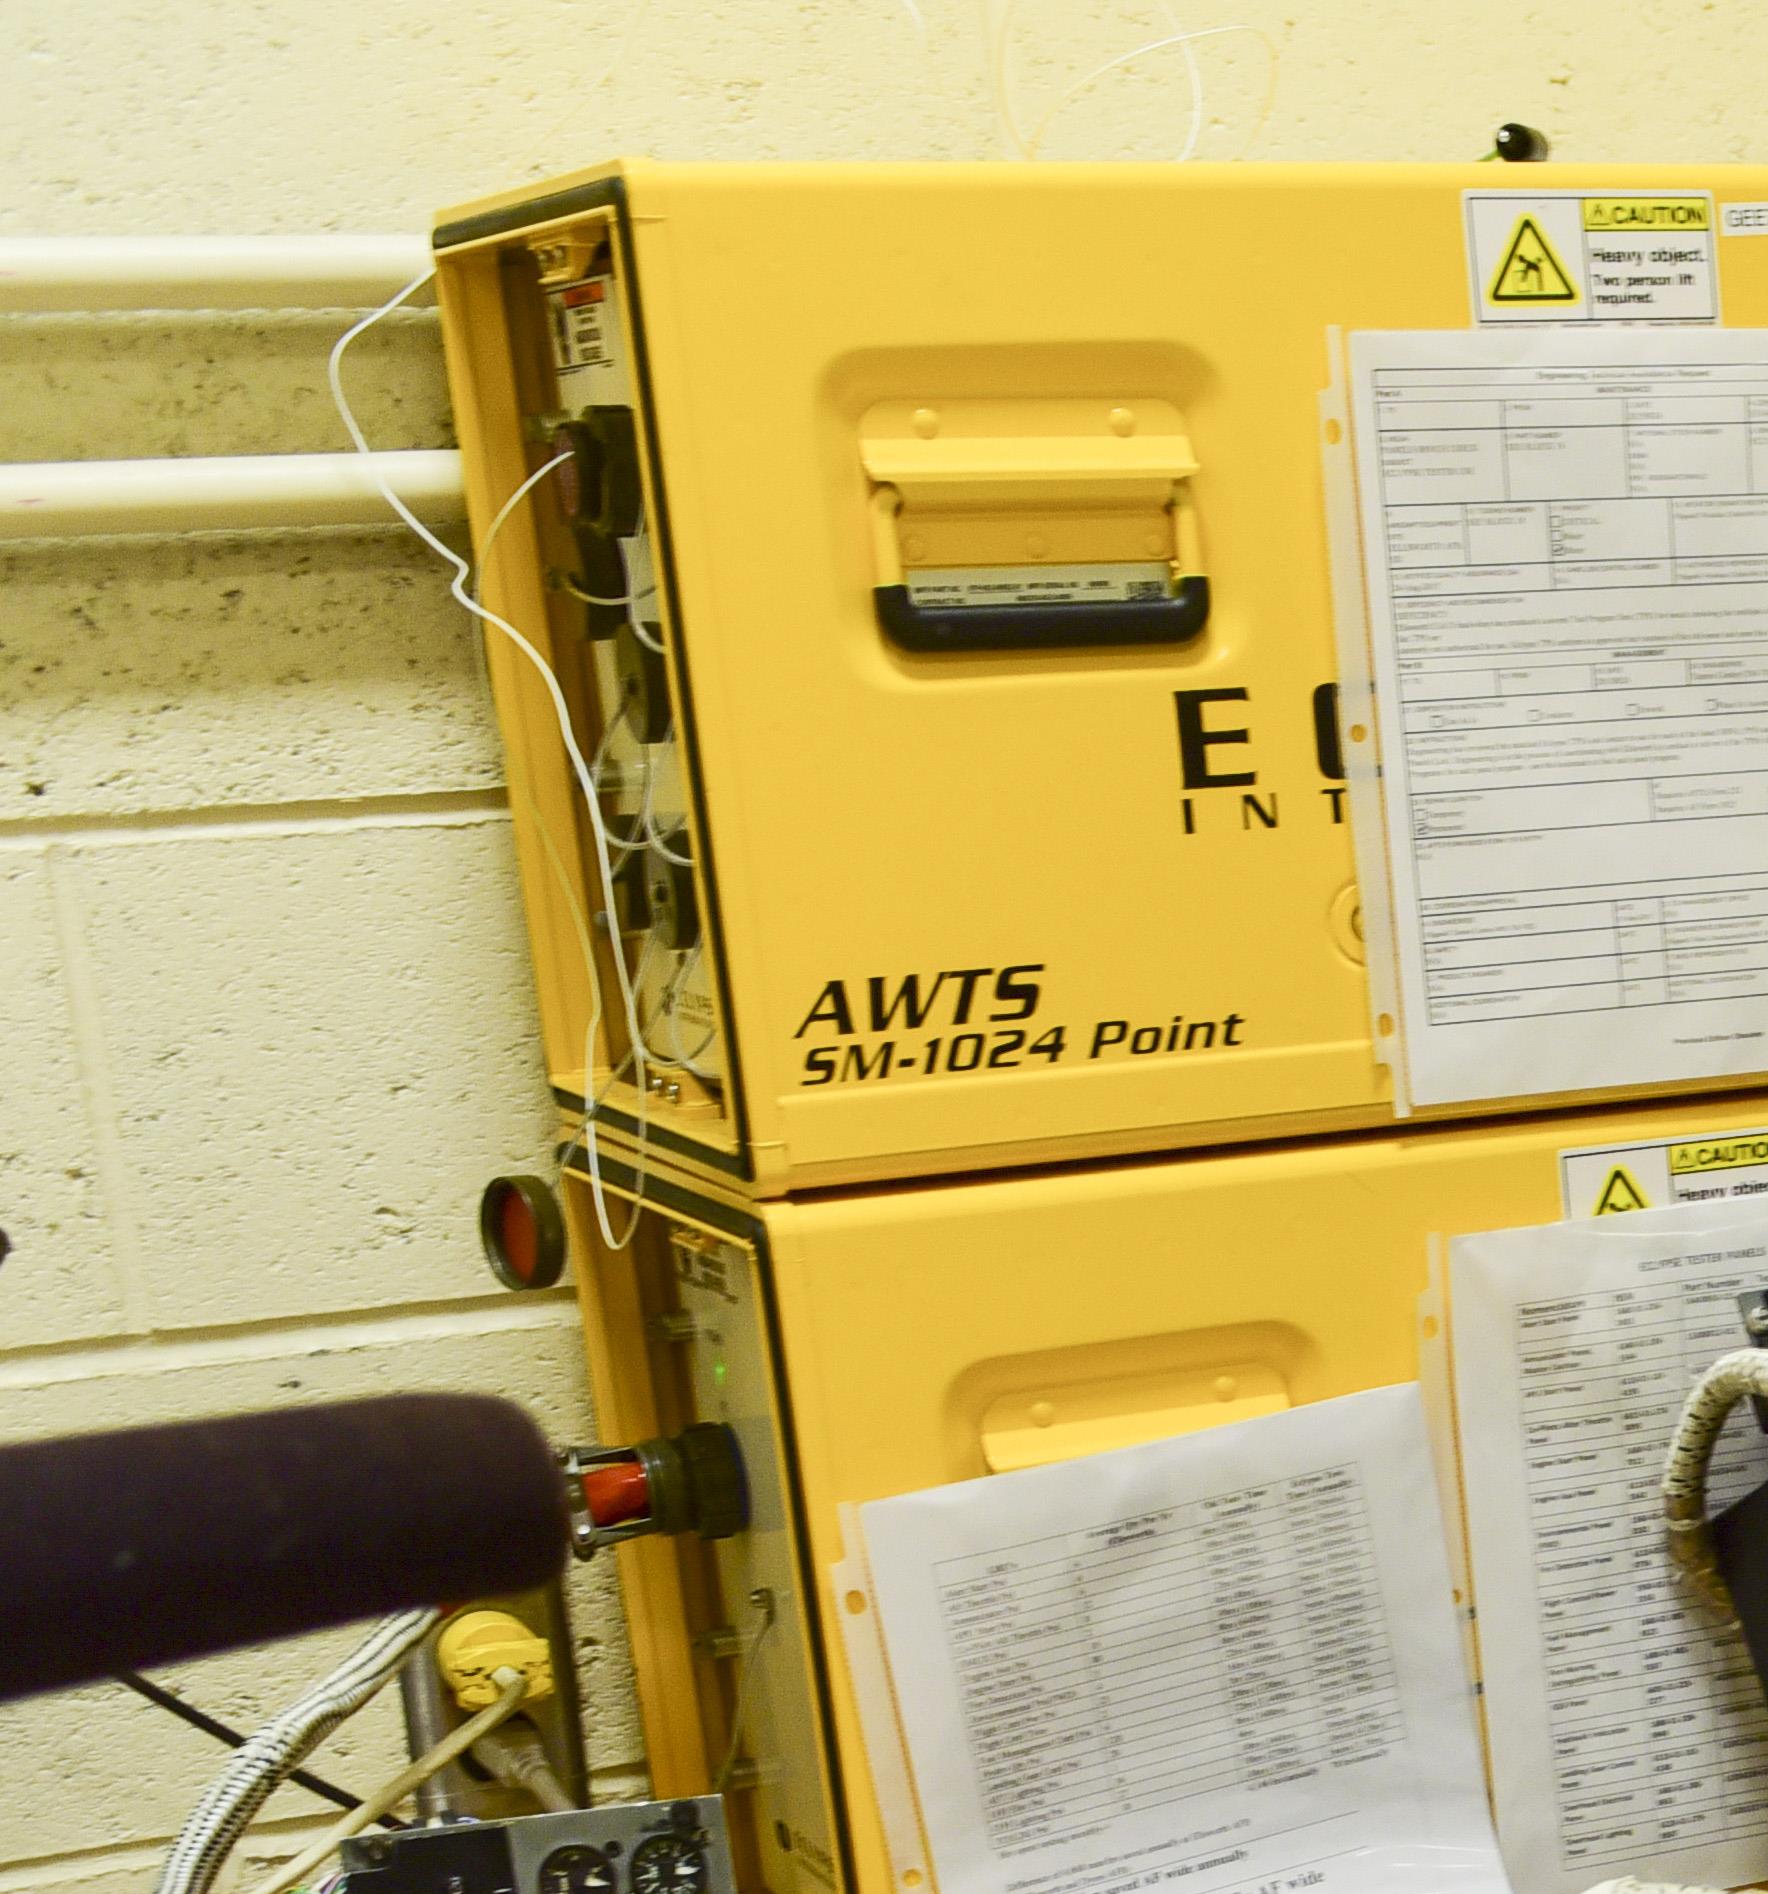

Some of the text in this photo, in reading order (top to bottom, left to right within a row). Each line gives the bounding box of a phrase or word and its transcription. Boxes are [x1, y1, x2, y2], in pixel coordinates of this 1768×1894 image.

[1613, 206, 1704, 225] CAUTION
[1593, 249, 1642, 266] Heavy
[1593, 273, 1620, 286] Two
[1627, 275, 1671, 288] person
[794, 963, 1045, 1039] AWTS
[800, 1012, 1246, 1086] SM-1024 Point
[1197, 1850, 1250, 1871] annually
[1287, 1870, 1325, 1891] wide
